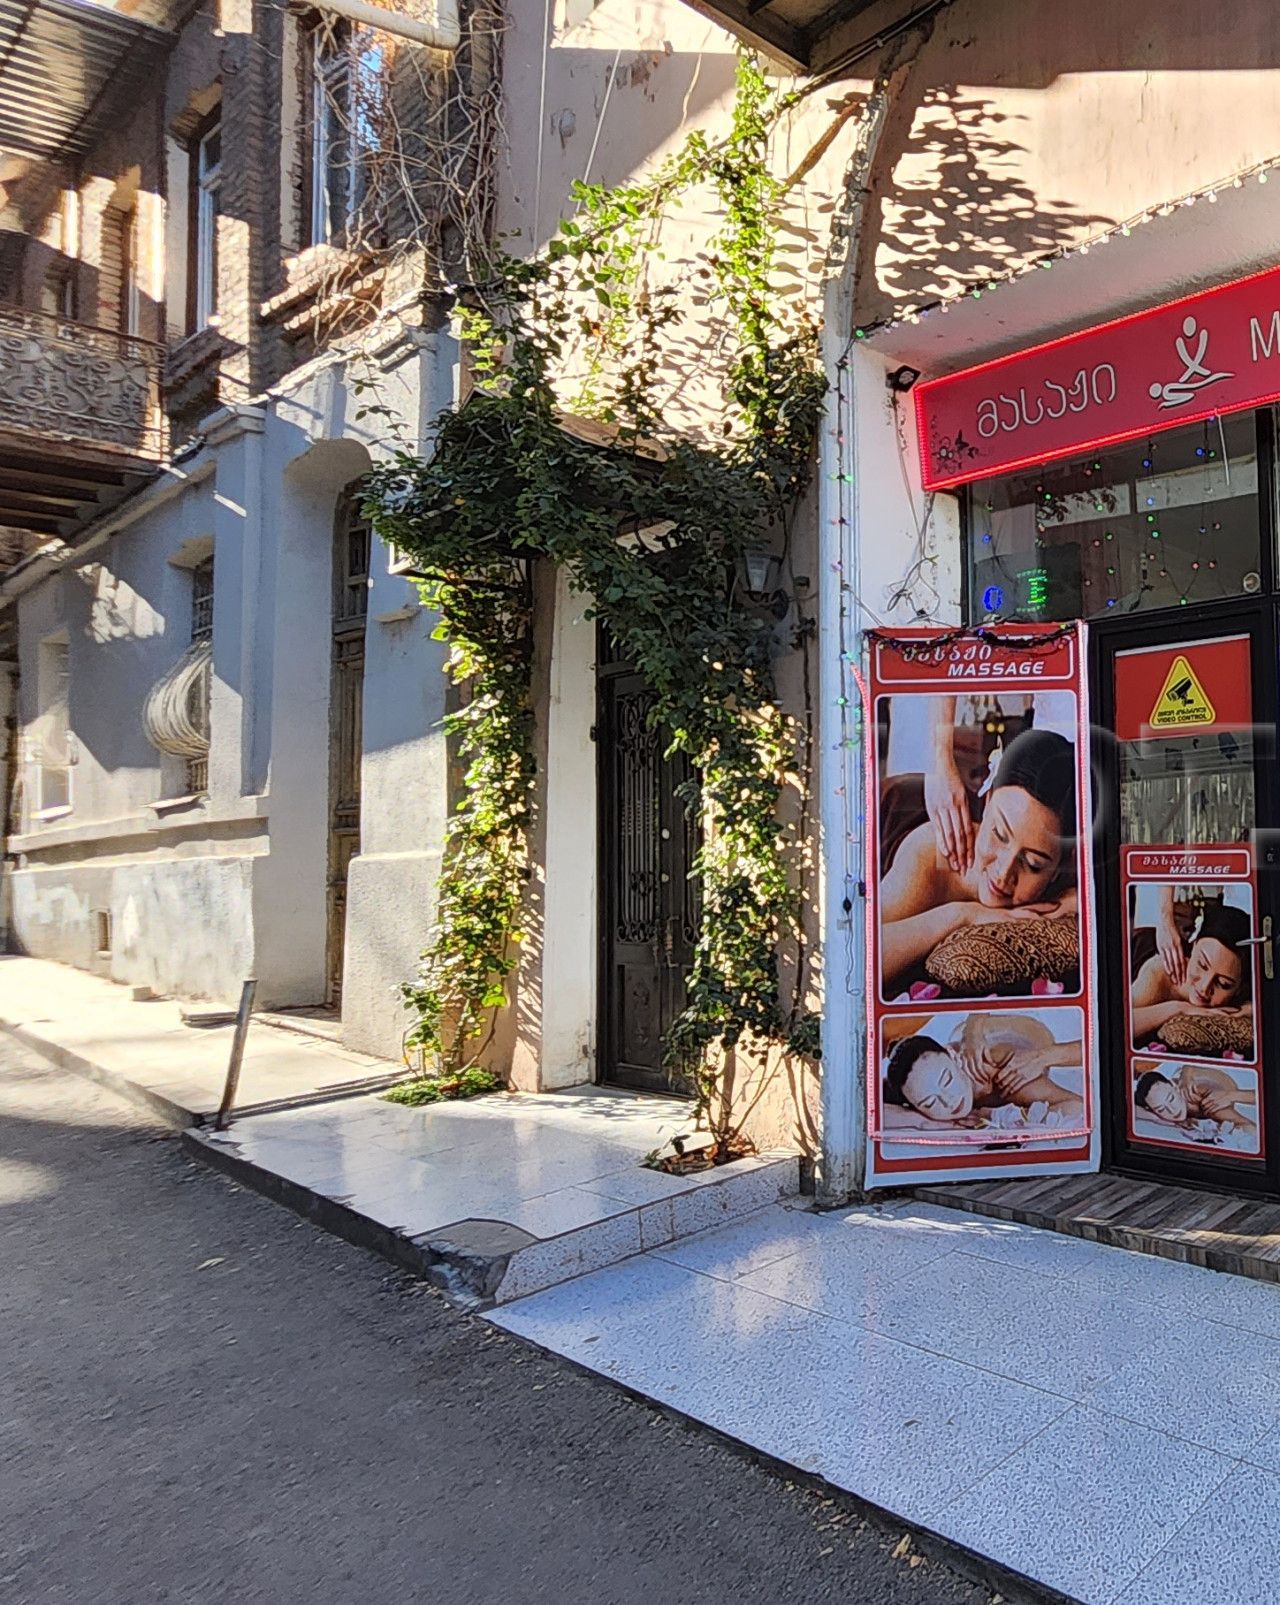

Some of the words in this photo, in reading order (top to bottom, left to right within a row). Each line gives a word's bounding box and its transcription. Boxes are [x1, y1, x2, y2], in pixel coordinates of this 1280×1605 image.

[976, 363, 1117, 438] მასაჟი
[947, 661, 1045, 676] MASSAGE
[1178, 713, 1207, 722] CONTROL
[1142, 855, 1197, 866] მასაჟი
[1169, 865, 1230, 874] MASSAGE
